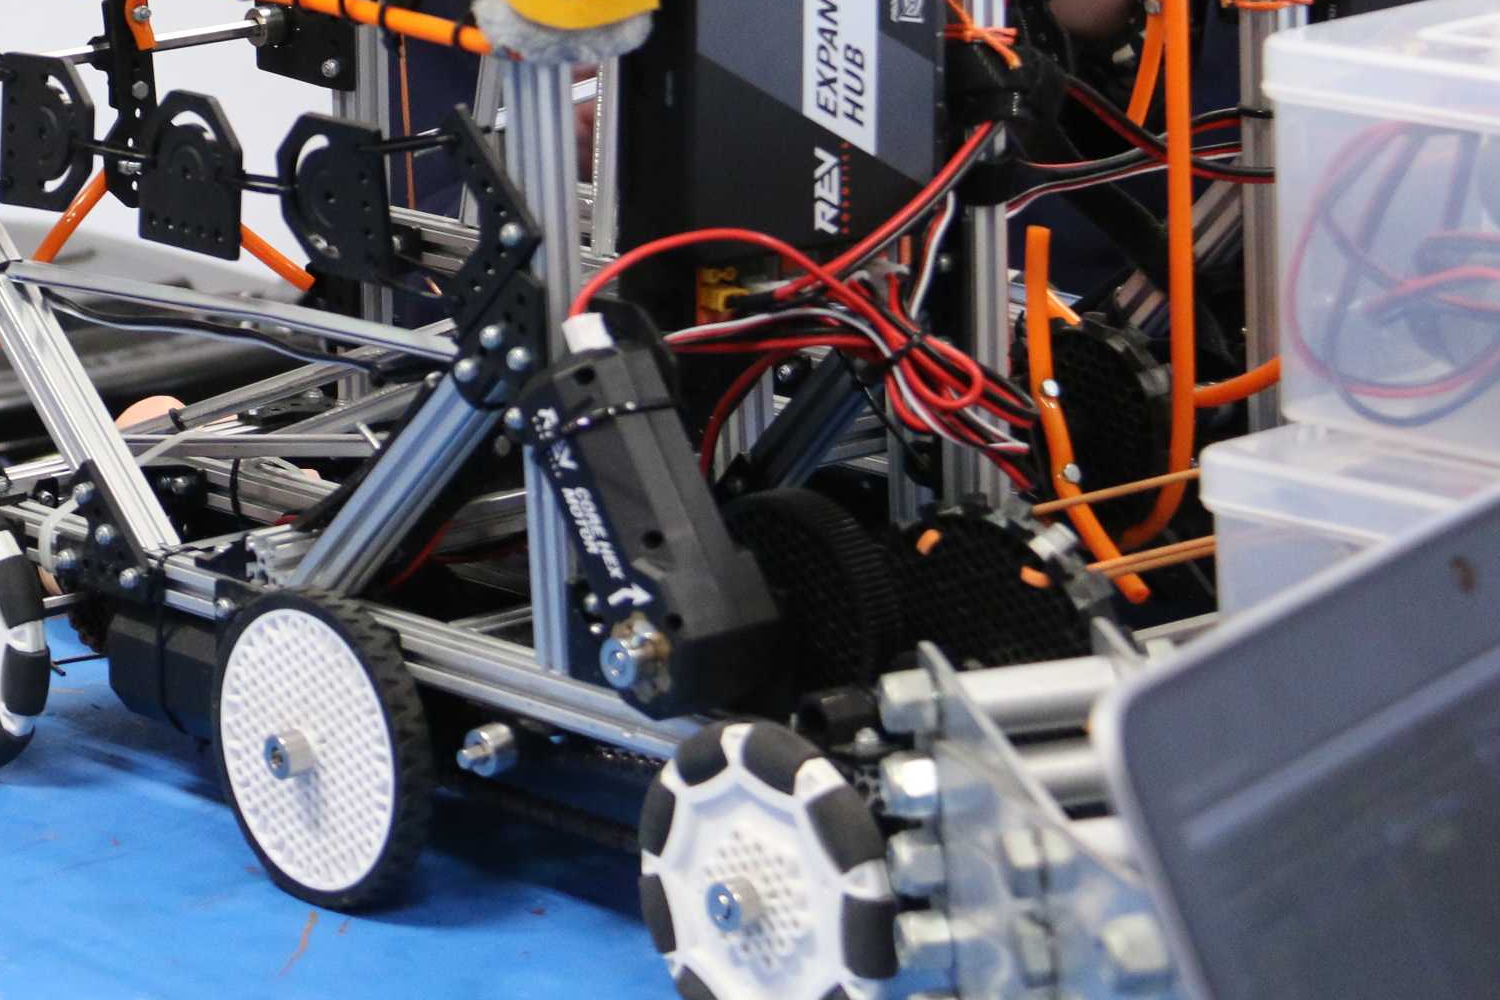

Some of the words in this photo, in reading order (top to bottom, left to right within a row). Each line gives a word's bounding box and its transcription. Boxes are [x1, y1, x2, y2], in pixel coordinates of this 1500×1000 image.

[843, 45, 866, 128] HUB
[814, 147, 842, 235] REV
[561, 486, 601, 555] MOTOR
[574, 486, 609, 538] CORE
[596, 540, 626, 580] HEX
